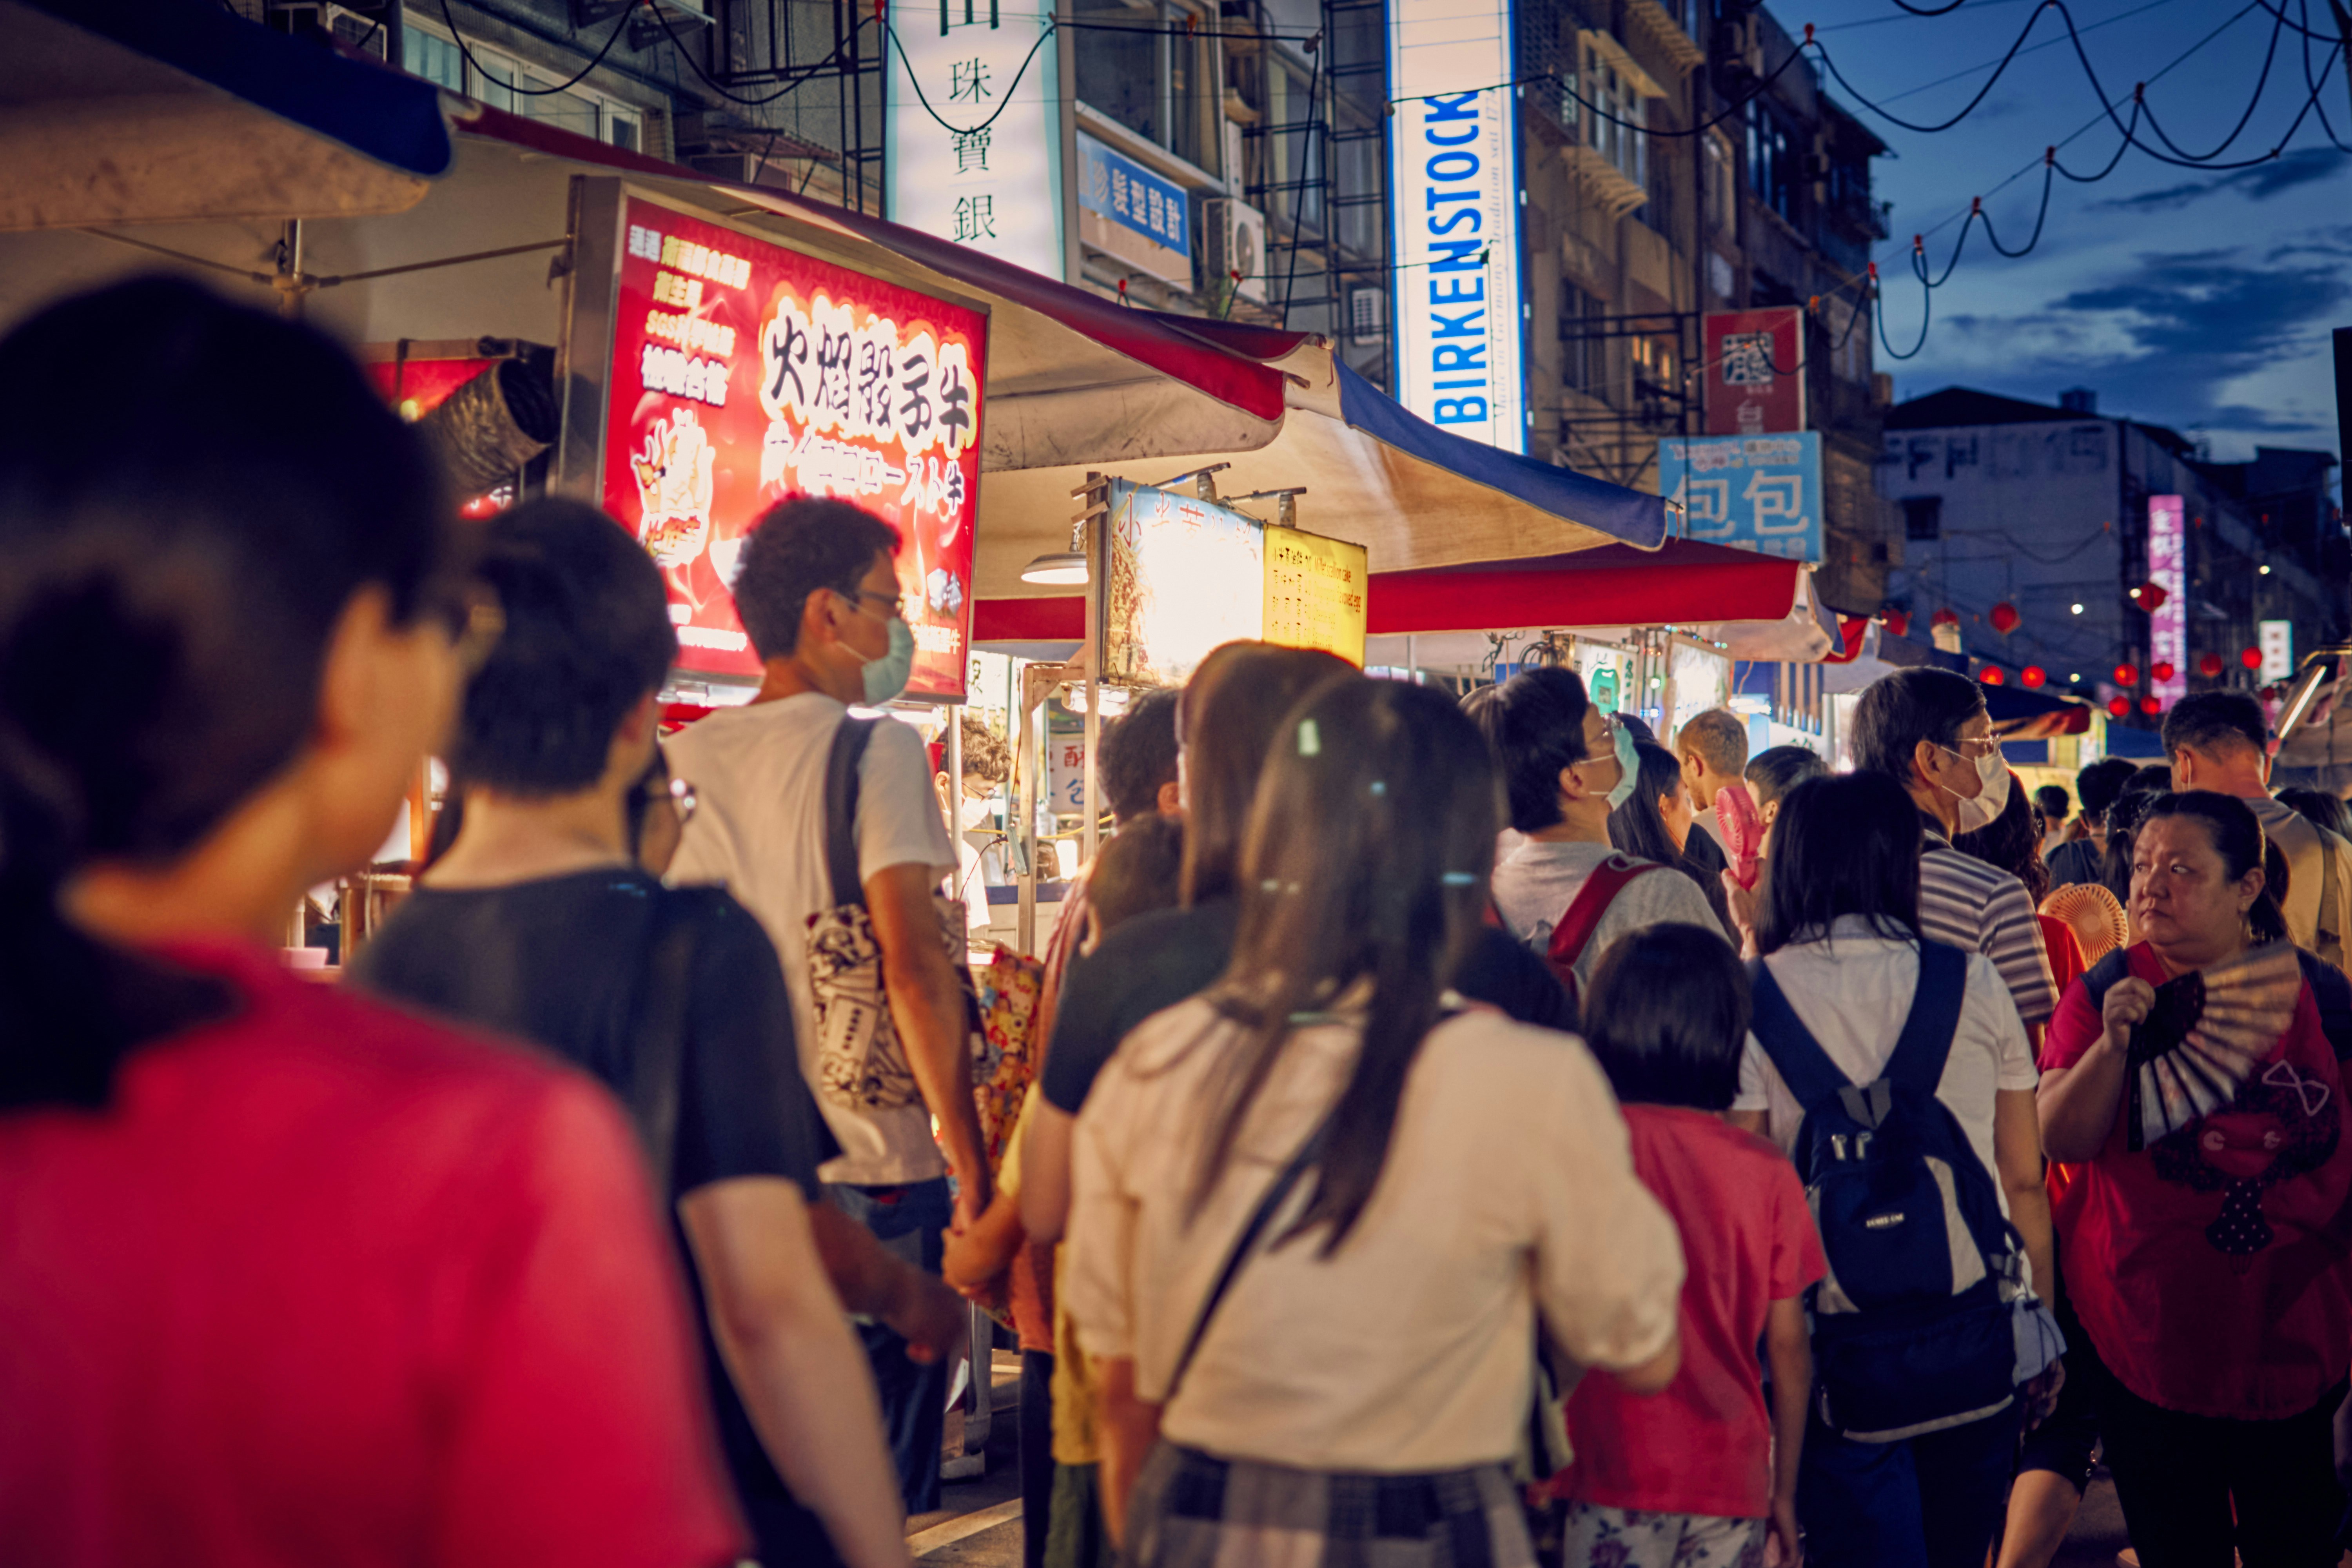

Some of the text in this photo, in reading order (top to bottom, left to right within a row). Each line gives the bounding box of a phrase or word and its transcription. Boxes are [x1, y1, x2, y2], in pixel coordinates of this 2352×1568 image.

[948, 57, 997, 243] 珠寶銀
[1423, 91, 1488, 425] BIRKENSTOCK
[770, 315, 969, 448] 火焰骰子牛
[1670, 470, 1809, 540] 包包
[1327, 561, 1341, 580] scallion
[1342, 564, 1351, 583] cake
